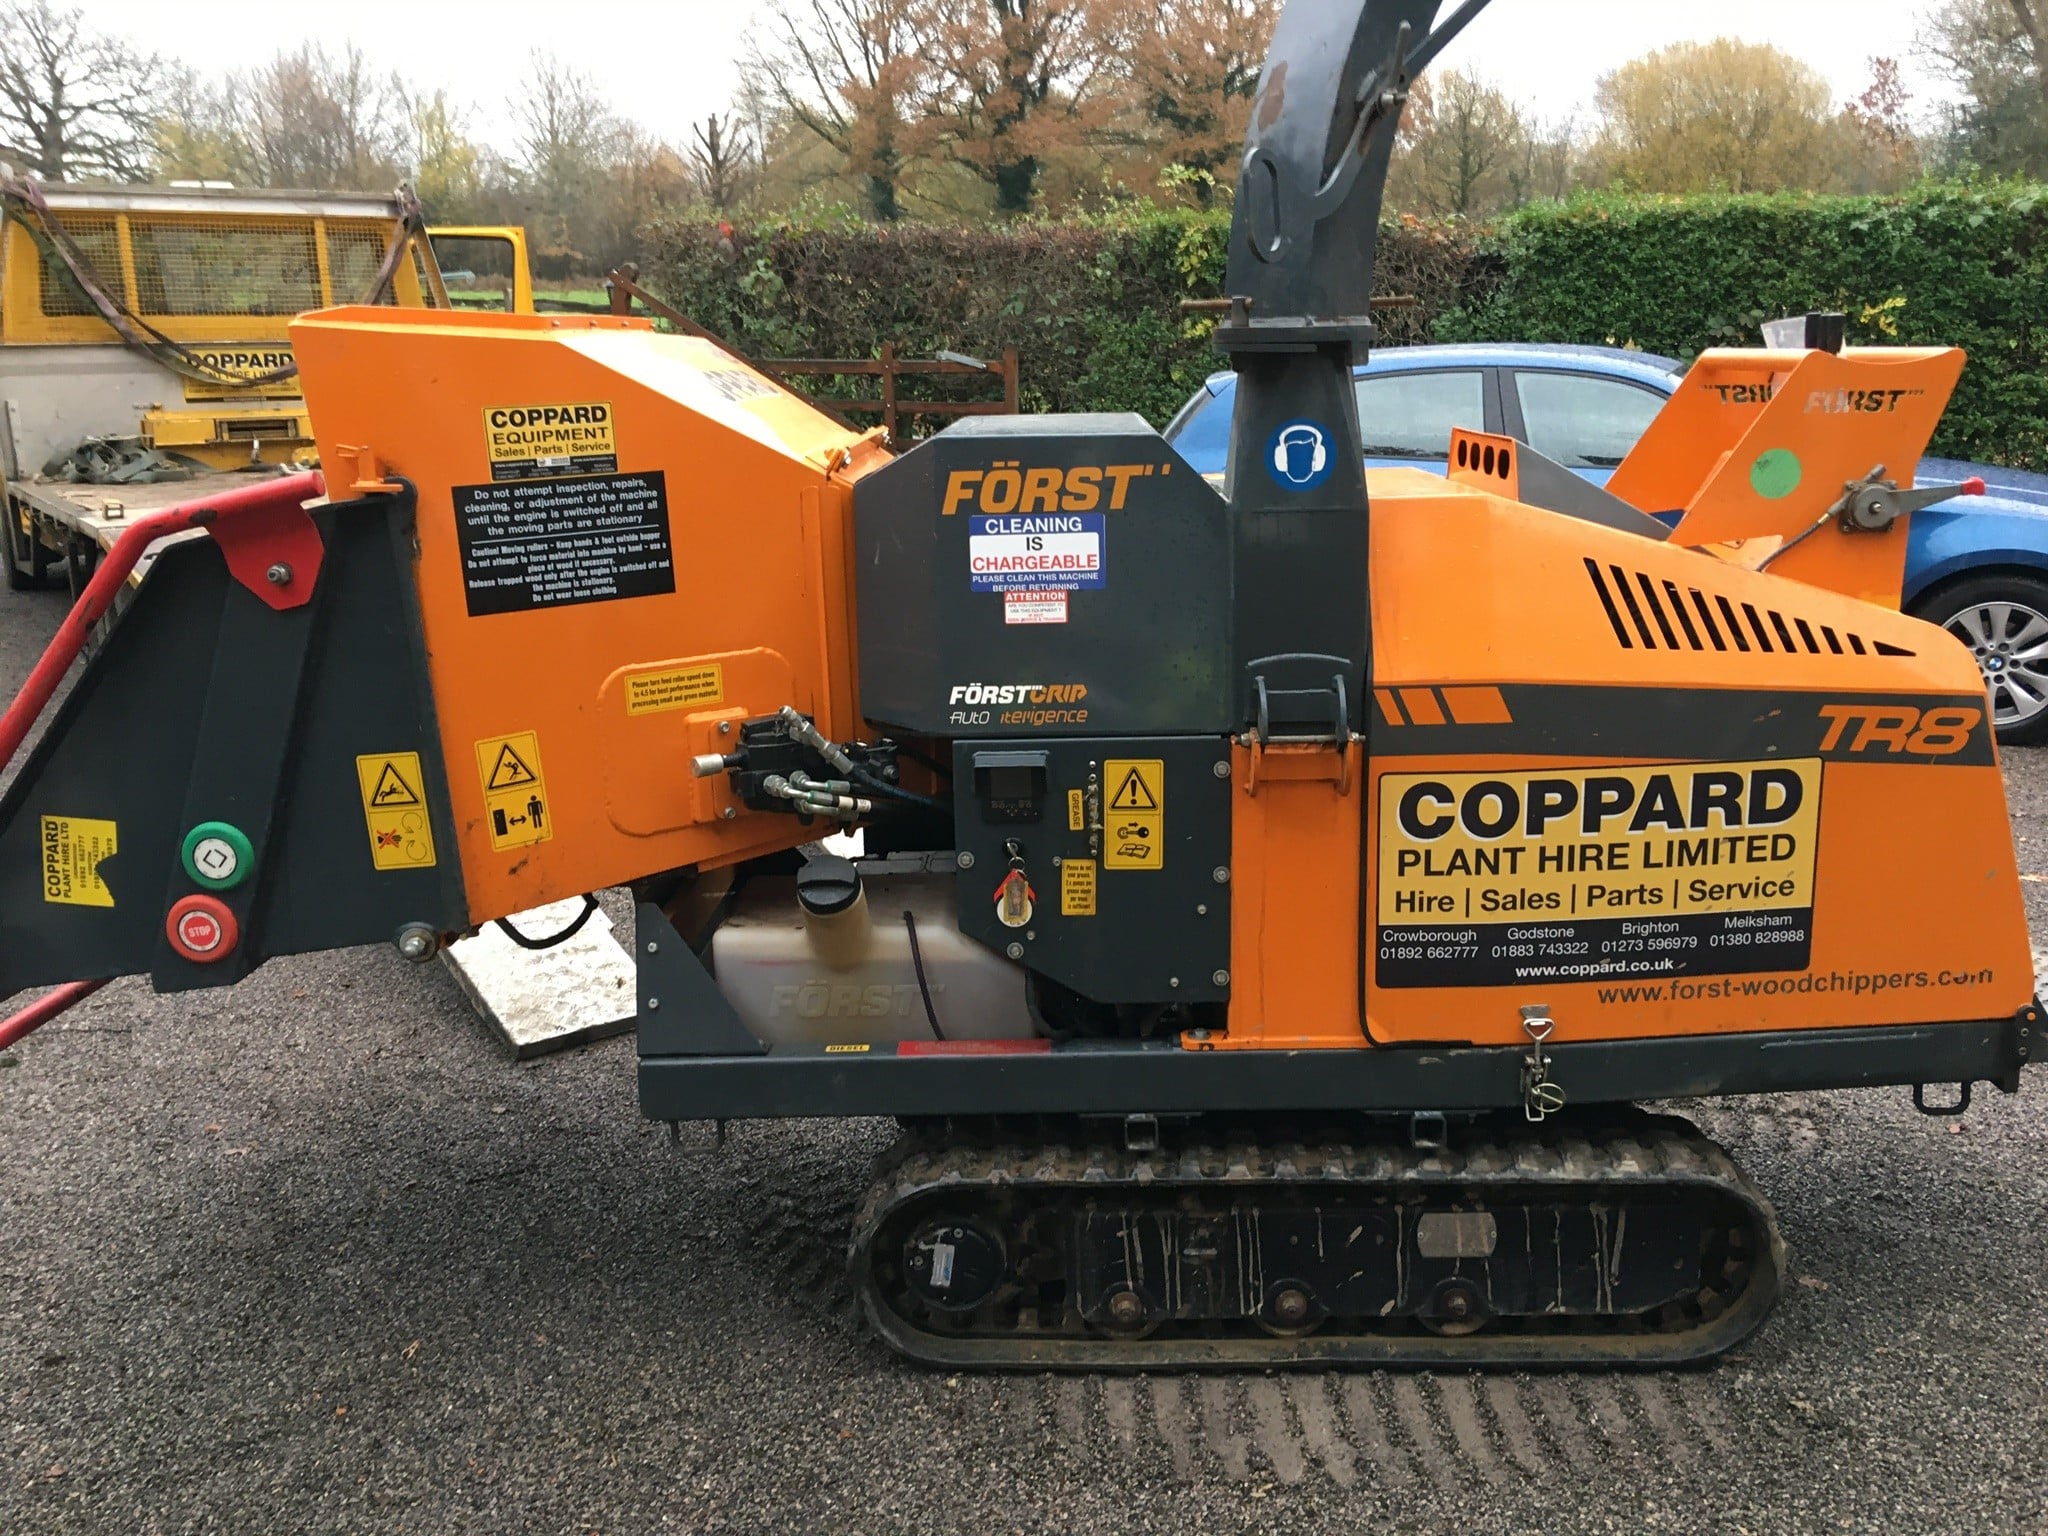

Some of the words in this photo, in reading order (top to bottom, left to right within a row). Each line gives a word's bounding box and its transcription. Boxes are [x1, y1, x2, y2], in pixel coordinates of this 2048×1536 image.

[491, 406, 607, 428] COPPARD
[493, 427, 608, 445] EQUIPMENT
[495, 447, 525, 457] Sales
[534, 444, 563, 455] Parts
[571, 442, 610, 453] Service
[474, 490, 489, 499] Do
[493, 489, 510, 498] not
[514, 486, 553, 497] attempt
[556, 481, 609, 493] inspection,
[612, 478, 647, 490] repairs,
[465, 502, 510, 513] cleaning,
[514, 501, 524, 509] or
[529, 495, 583, 508] adjustment
[587, 494, 597, 503] of
[601, 493, 616, 501] the
[620, 489, 657, 500] machine
[468, 515, 489, 526] until
[494, 514, 510, 523] the
[514, 511, 547, 522] engine
[550, 509, 559, 518] is
[563, 505, 606, 517] switched
[610, 504, 623, 513] off
[627, 502, 644, 511] and
[648, 501, 657, 509] all
[488, 527, 504, 536] the
[508, 523, 544, 534] moving
[547, 520, 573, 532] parts
[577, 520, 592, 528] are
[596, 515, 642, 526] stationary
[985, 517, 1082, 534] CLEANING
[501, 545, 525, 554] Moving
[527, 543, 548, 552] rollers
[556, 540, 572, 549] Keep
[574, 537, 592, 547] hands
[616, 534, 638, 543] outside
[640, 532, 660, 541] hopper
[1026, 537, 1043, 551] IS
[468, 560, 477, 568] Do
[479, 558, 490, 568] not
[492, 556, 519, 566] attempt
[521, 555, 528, 563] to
[530, 554, 547, 562] force
[548, 551, 575, 560] material
[577, 549, 590, 557] into
[591, 547, 616, 556] machine
[619, 546, 626, 554] by
[627, 543, 642, 552] hand
[973, 554, 1098, 571] CHARGEABLE
[469, 579, 496, 588] Release
[497, 575, 523, 586] trapped
[524, 574, 542, 582] wood
[543, 572, 557, 581] only
[560, 570, 575, 578] after
[577, 569, 588, 577] the
[589, 567, 610, 576] engine
[611, 565, 618, 573] is
[620, 561, 646, 572] switched
[648, 561, 657, 569] off
[659, 559, 669, 568] and
[527, 564, 545, 574] piece
[547, 562, 554, 570] of
[556, 561, 573, 570] wood
[973, 574, 1004, 582] PLEASE
[1007, 574, 1035, 582] CLEAN
[1038, 573, 1056, 581] THIS
[1059, 572, 1098, 580] MACHINE
[533, 583, 544, 592] the
[545, 581, 571, 590] machine
[533, 594, 541, 602] Do
[543, 592, 554, 600] not
[556, 591, 571, 599] wear
[574, 588, 590, 597] loose
[592, 586, 617, 595] clothing
[1006, 592, 1065, 601] ATTENTION
[1029, 583, 1079, 591] RETURNING
[673, 675, 685, 683] roller
[687, 673, 701, 681] speed
[632, 699, 659, 709] processing
[684, 692, 697, 702] green
[699, 689, 718, 698] material
[640, 689, 648, 697] 4.5
[670, 683, 700, 694] performance
[1818, 704, 1982, 754] TR8
[1072, 792, 1080, 828] GREASE
[1398, 768, 1804, 842] COPPARD
[60, 822, 69, 839] LTD
[45, 820, 61, 897] COPPARD
[61, 842, 70, 865] HIRE
[1398, 847, 1526, 876] PLANT
[1538, 842, 1630, 873] HIRE
[1643, 833, 1796, 869] LIMITED
[62, 868, 71, 898] PLANT
[1395, 889, 1455, 913] Hire
[1480, 887, 1561, 912] Sales
[1587, 883, 1664, 907] Parts
[1688, 876, 1796, 903] Service
[188, 925, 211, 937] STOP
[1383, 928, 1478, 946] Crowborough
[1507, 926, 1575, 940] Godstone
[1622, 921, 1680, 938] Brighton
[1724, 914, 1793, 929] Melksham
[1380, 946, 1424, 960] 01892
[1427, 945, 1479, 959] 662777
[1491, 944, 1536, 958] 01883
[1538, 942, 1589, 956] 743322
[1601, 939, 1645, 953] 01273
[1647, 936, 1698, 951] 596979
[1709, 934, 1753, 948] 01380
[1755, 930, 1805, 945] 828988
[1515, 958, 1674, 978] www.coppard.co.uk
